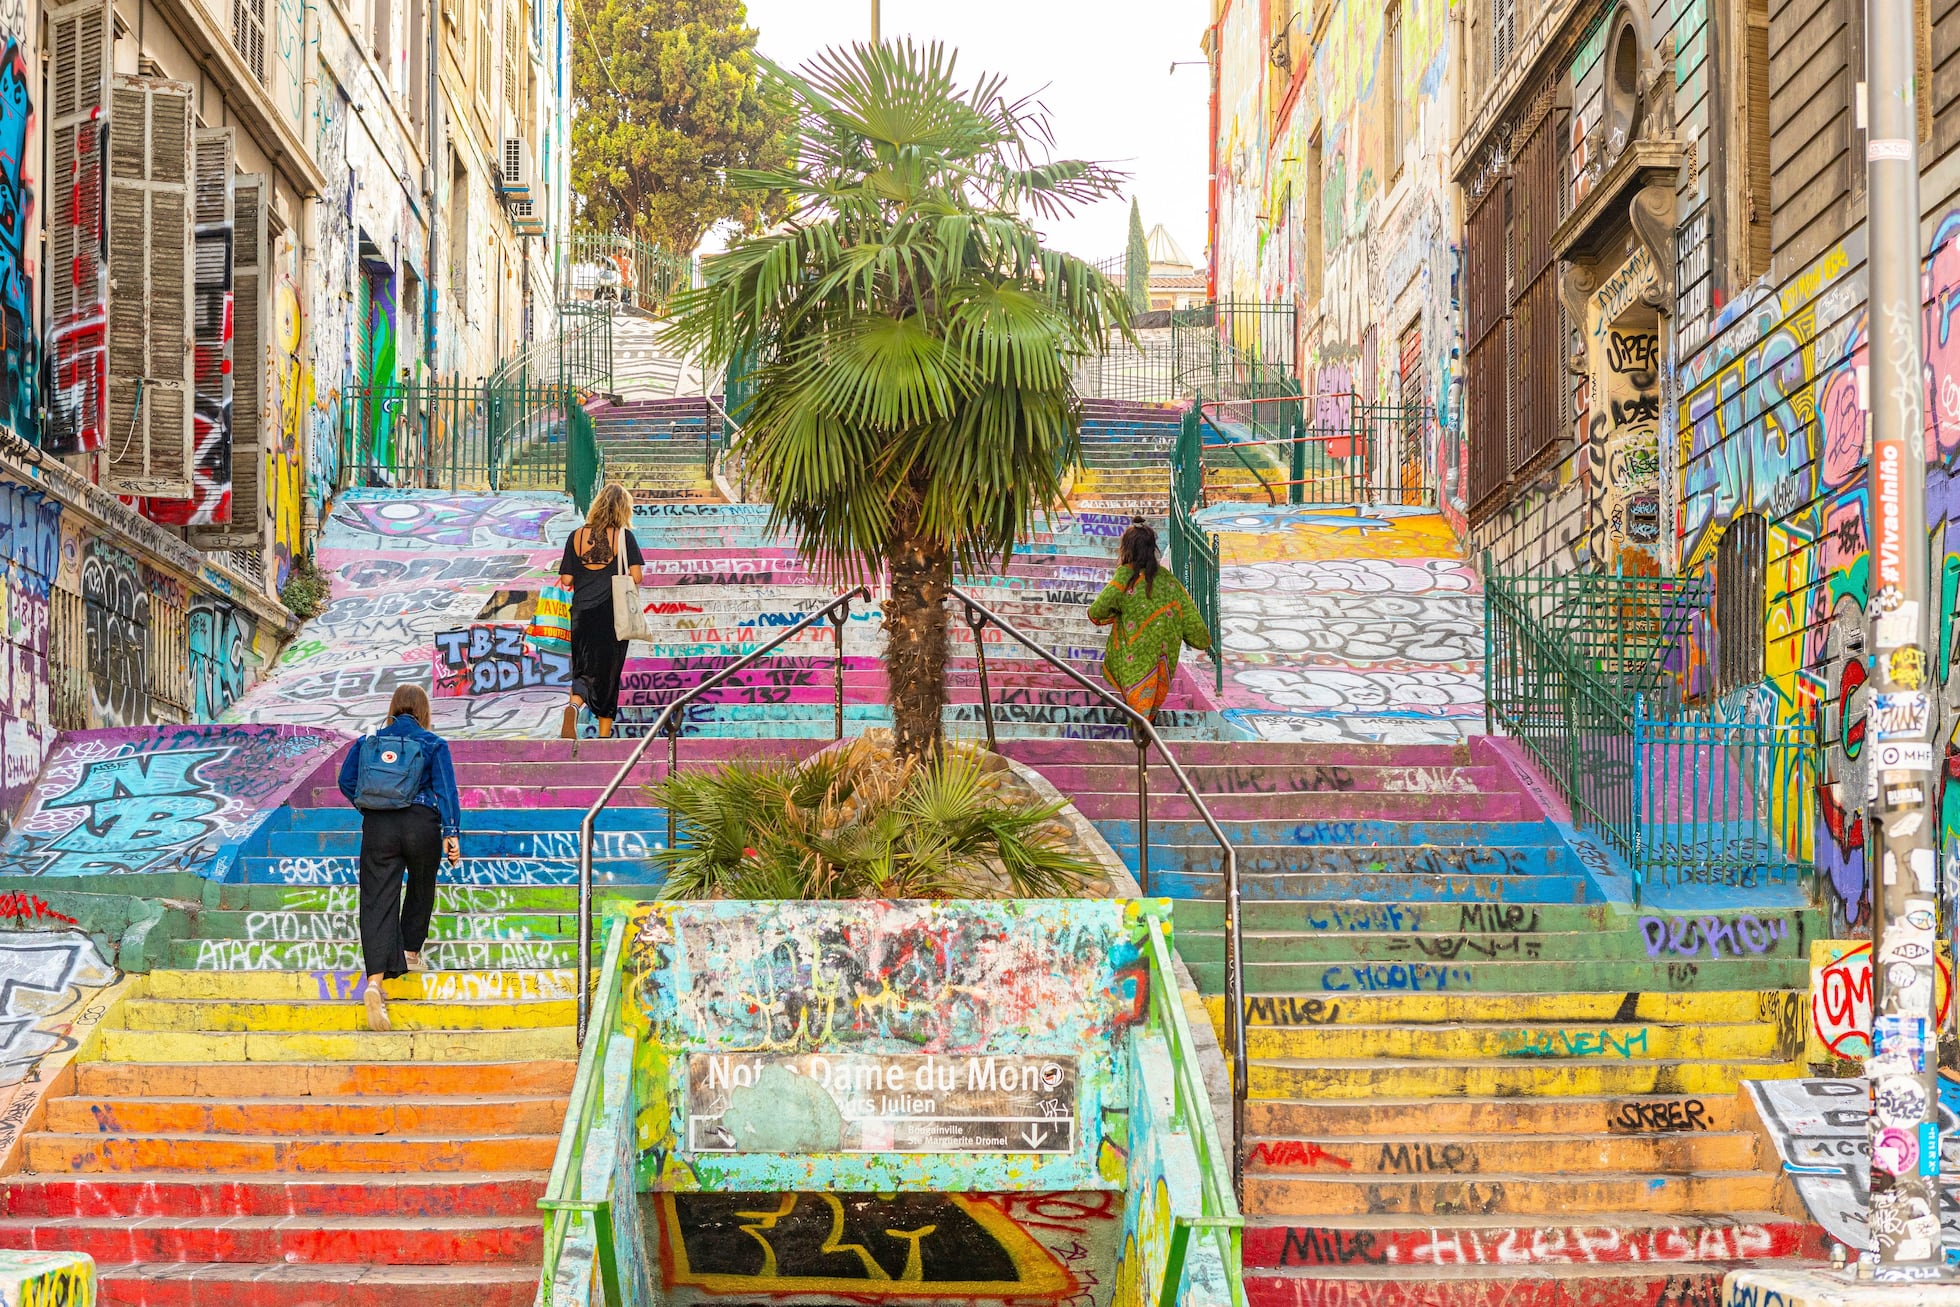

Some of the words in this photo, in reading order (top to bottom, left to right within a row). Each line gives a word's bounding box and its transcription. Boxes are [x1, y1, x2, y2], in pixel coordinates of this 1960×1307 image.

[708, 1055, 800, 1090] Not
[811, 1057, 904, 1090] Dame
[915, 1056, 956, 1091] du
[880, 1095, 936, 1115] Julien
[975, 1136, 1008, 1147] Dromel
